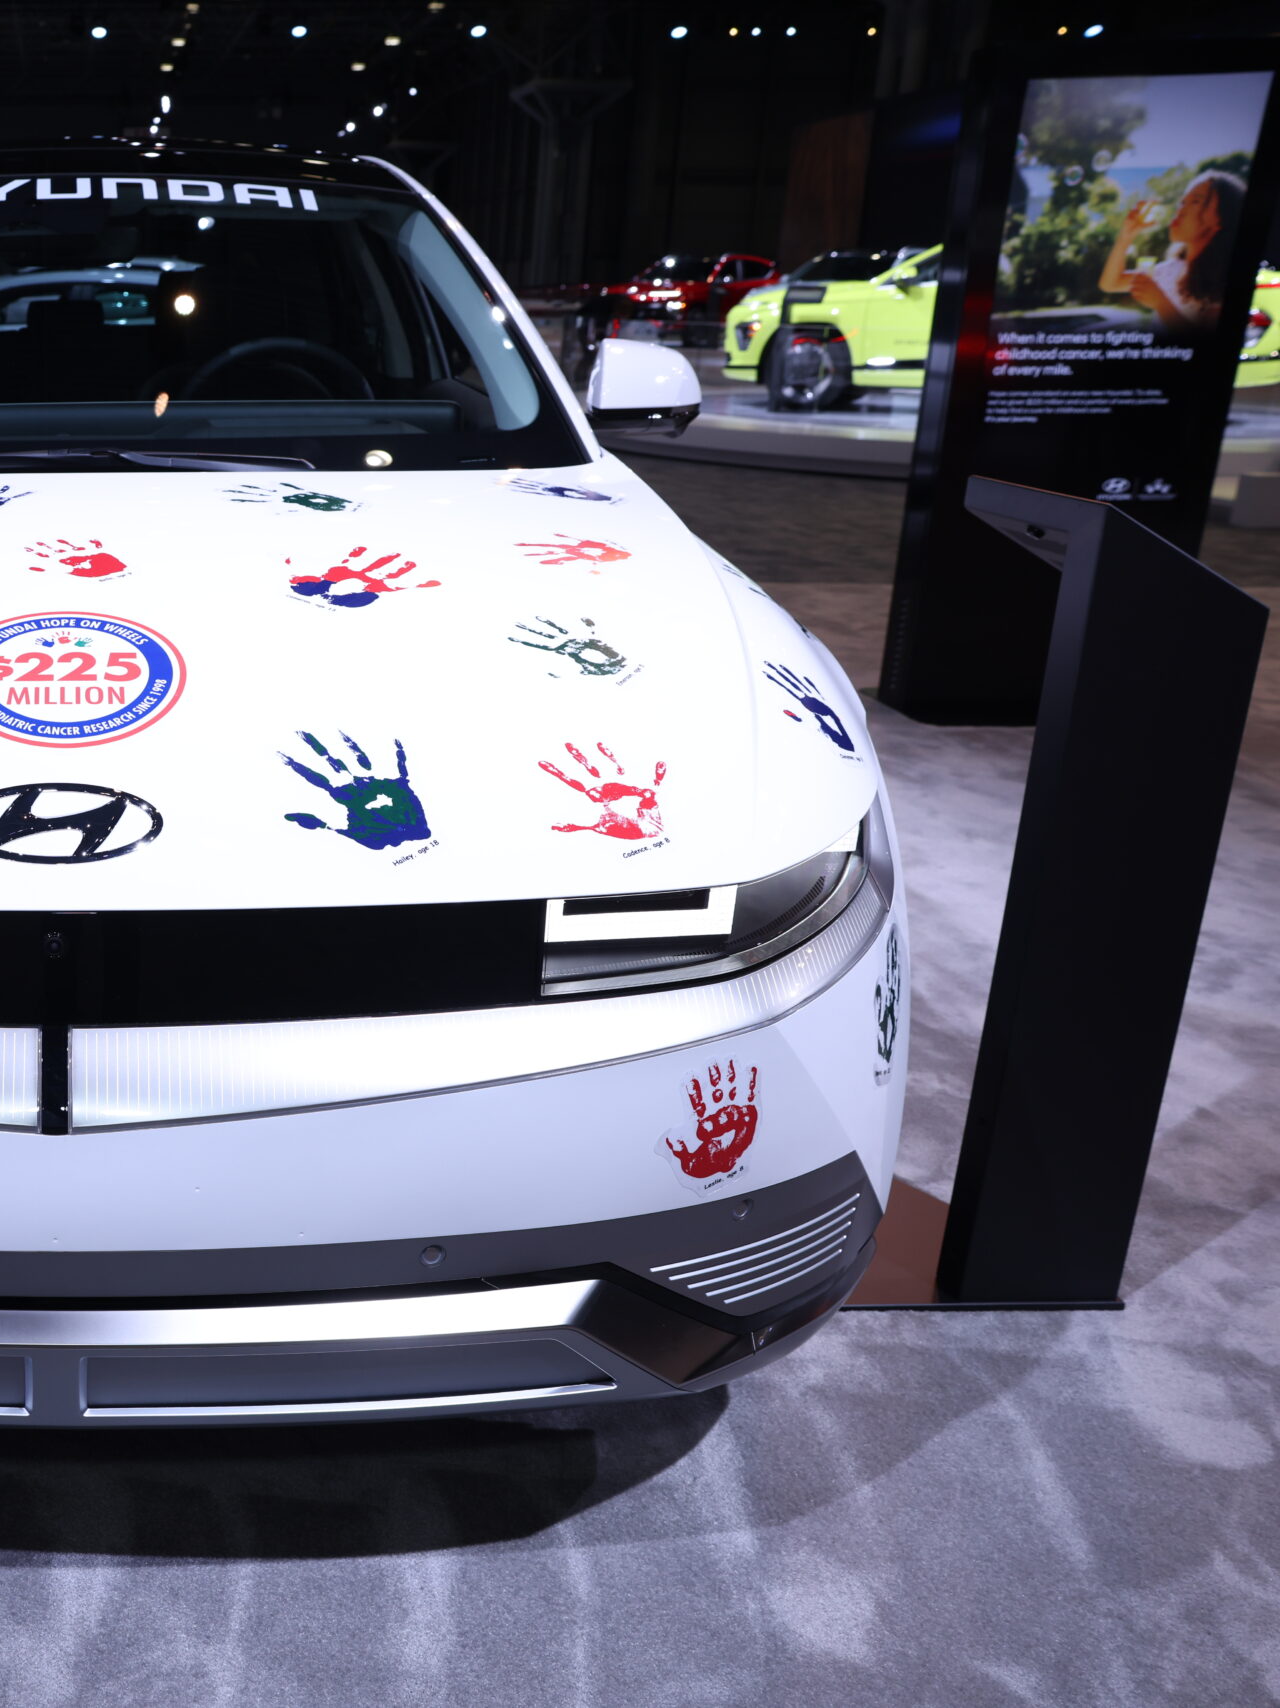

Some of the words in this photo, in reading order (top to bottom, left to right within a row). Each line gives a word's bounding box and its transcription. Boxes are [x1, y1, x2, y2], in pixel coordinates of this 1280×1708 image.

[997, 331, 1035, 345] When
[1036, 330, 1046, 345] it
[1046, 333, 1089, 345] comes
[1090, 331, 1104, 345] to
[1105, 330, 1154, 346] fighting
[994, 347, 1059, 361] childhood
[1141, 345, 1195, 361] thinking
[992, 363, 1008, 376] of
[1007, 365, 1041, 378] every
[40, 618, 76, 628] HOPE
[80, 619, 102, 629] ON
[103, 624, 149, 646] WHEELS
[6, 686, 126, 705] MILLION
[37, 725, 81, 736] CANCER
[83, 711, 137, 734] RESEARCH
[132, 695, 158, 715] SINCE
[149, 679, 168, 696] 1998
[417, 845, 430, 855] age
[429, 839, 439, 848] 18
[652, 840, 664, 849] age
